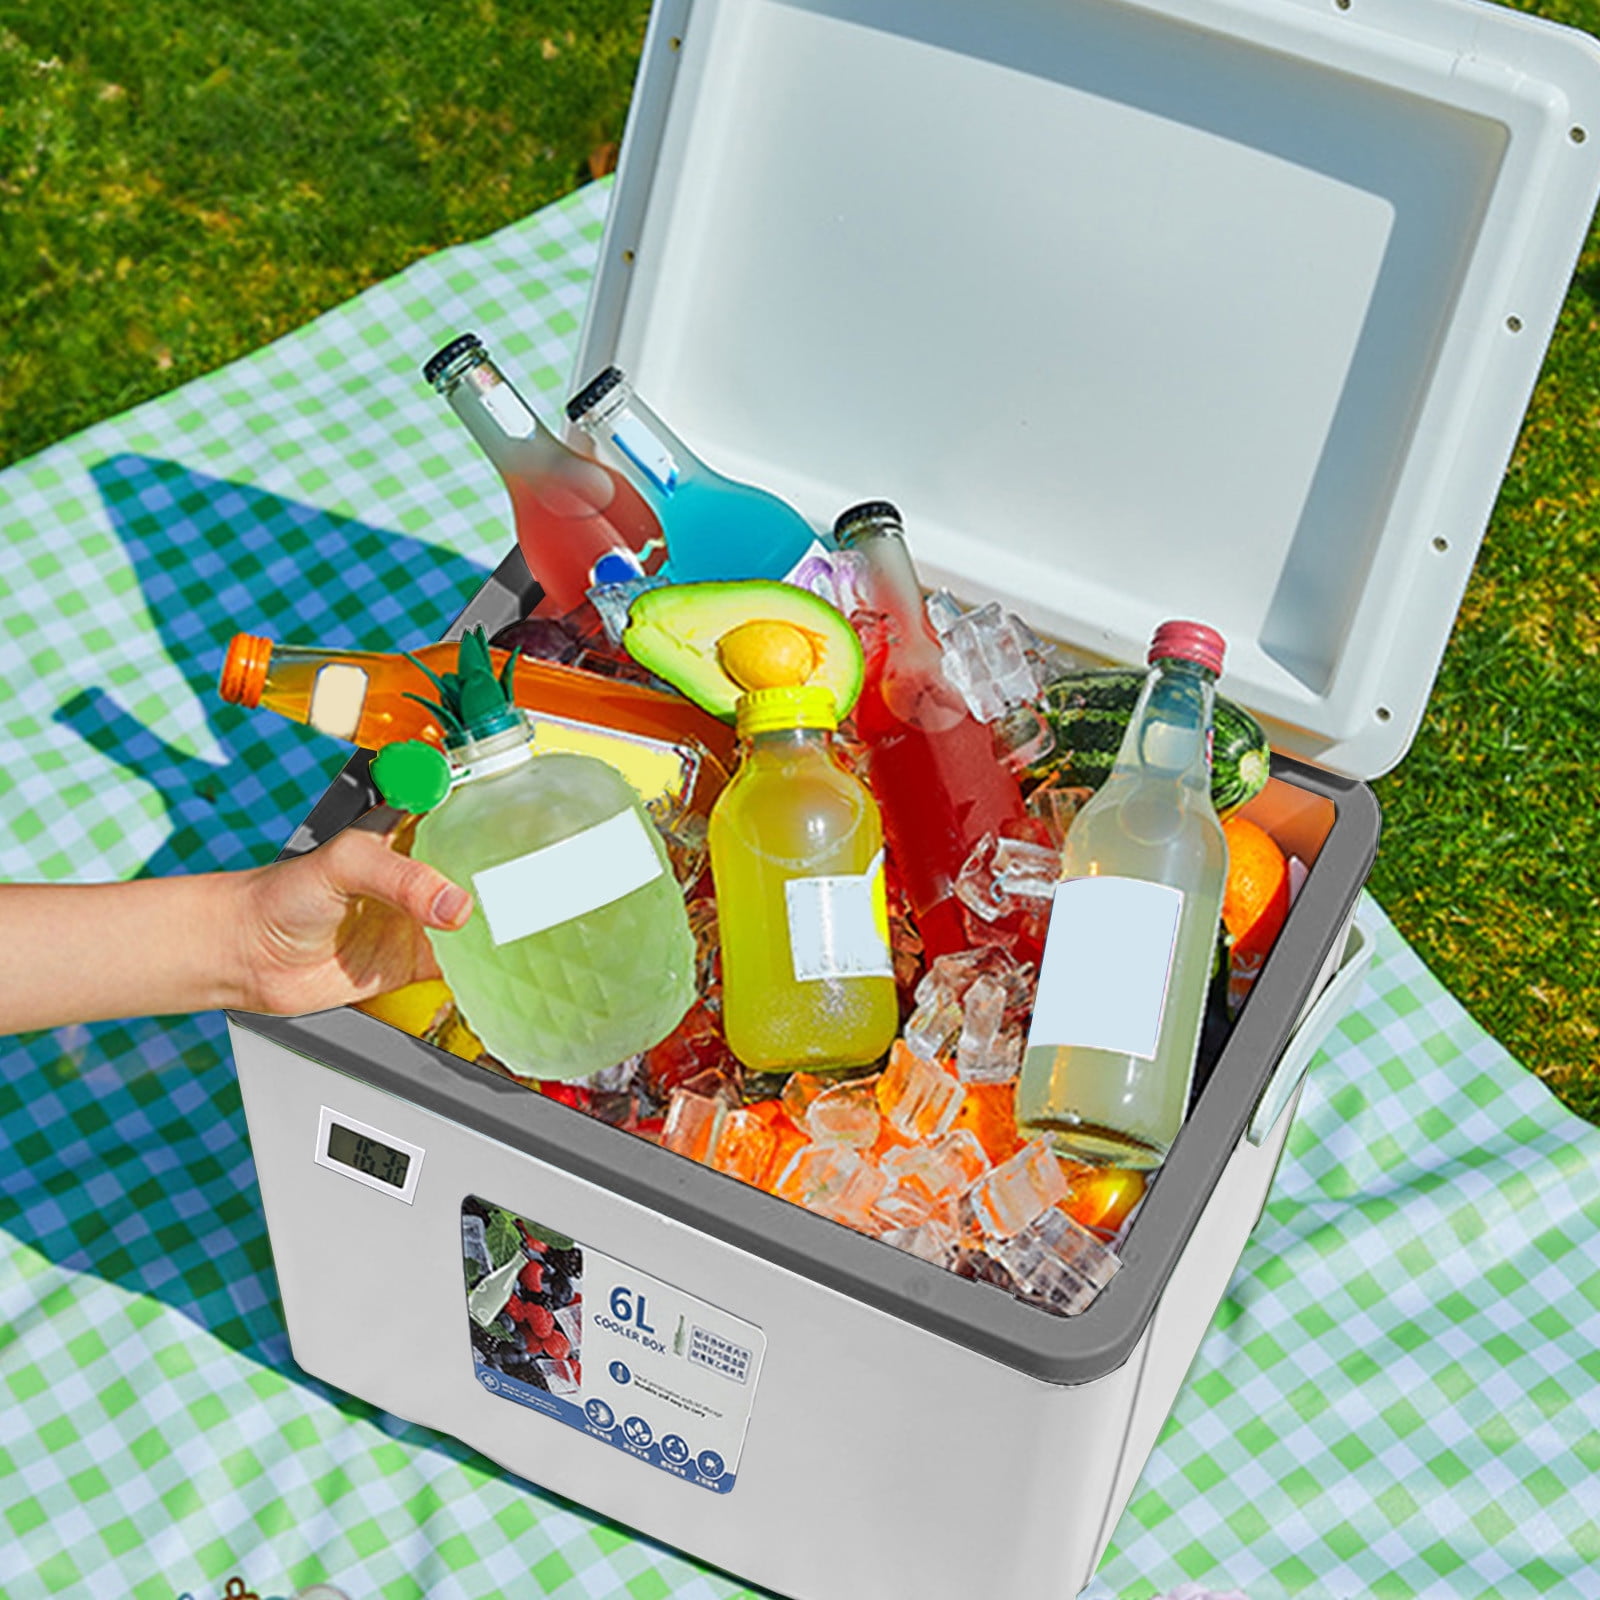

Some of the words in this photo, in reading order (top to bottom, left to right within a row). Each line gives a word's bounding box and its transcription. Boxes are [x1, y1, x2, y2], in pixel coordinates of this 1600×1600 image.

[610, 1286, 655, 1334] 6L
[593, 1314, 639, 1343] COOLER
[641, 1335, 666, 1355] BOX
